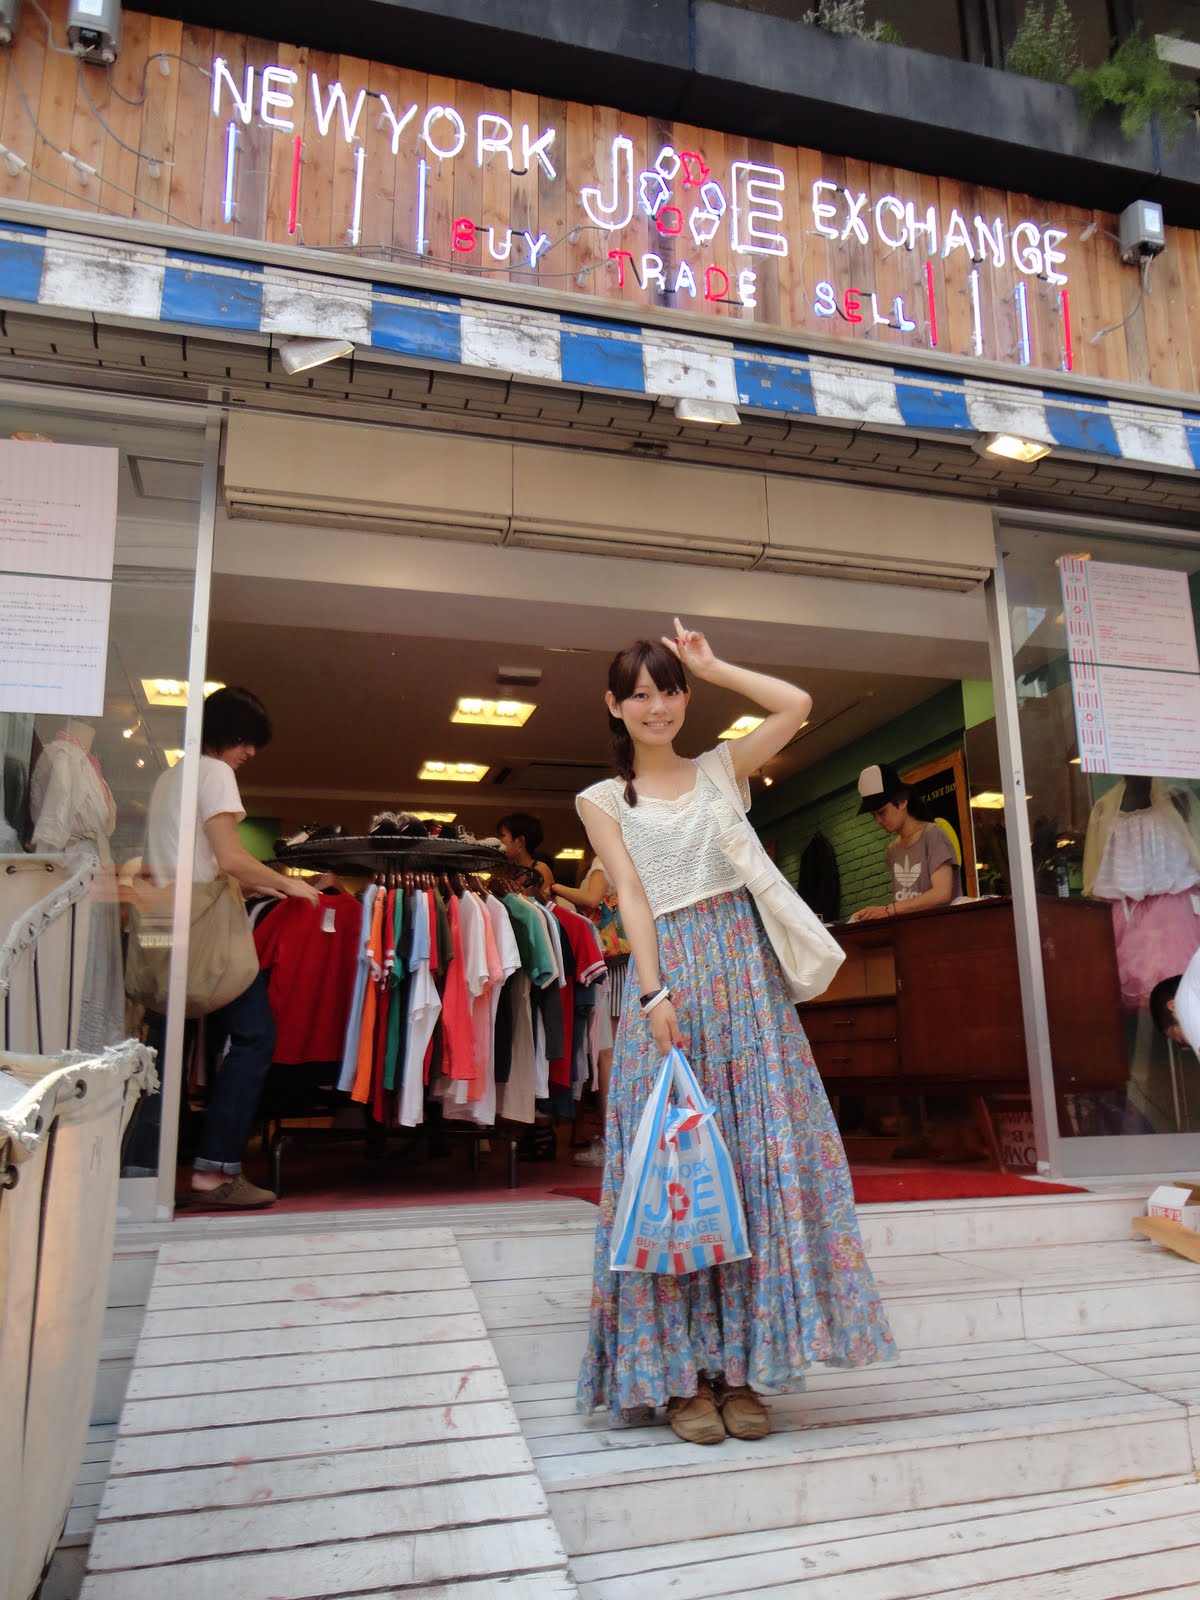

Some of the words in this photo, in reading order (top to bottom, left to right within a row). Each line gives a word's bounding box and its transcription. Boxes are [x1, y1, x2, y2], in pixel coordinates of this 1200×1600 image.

[452, 218, 550, 267] BUY
[608, 250, 758, 308] TRADE
[813, 281, 917, 332] SELL
[811, 178, 1069, 285] EXCHANGE
[636, 1237, 658, 1249] BUY
[699, 1234, 726, 1245] SELL
